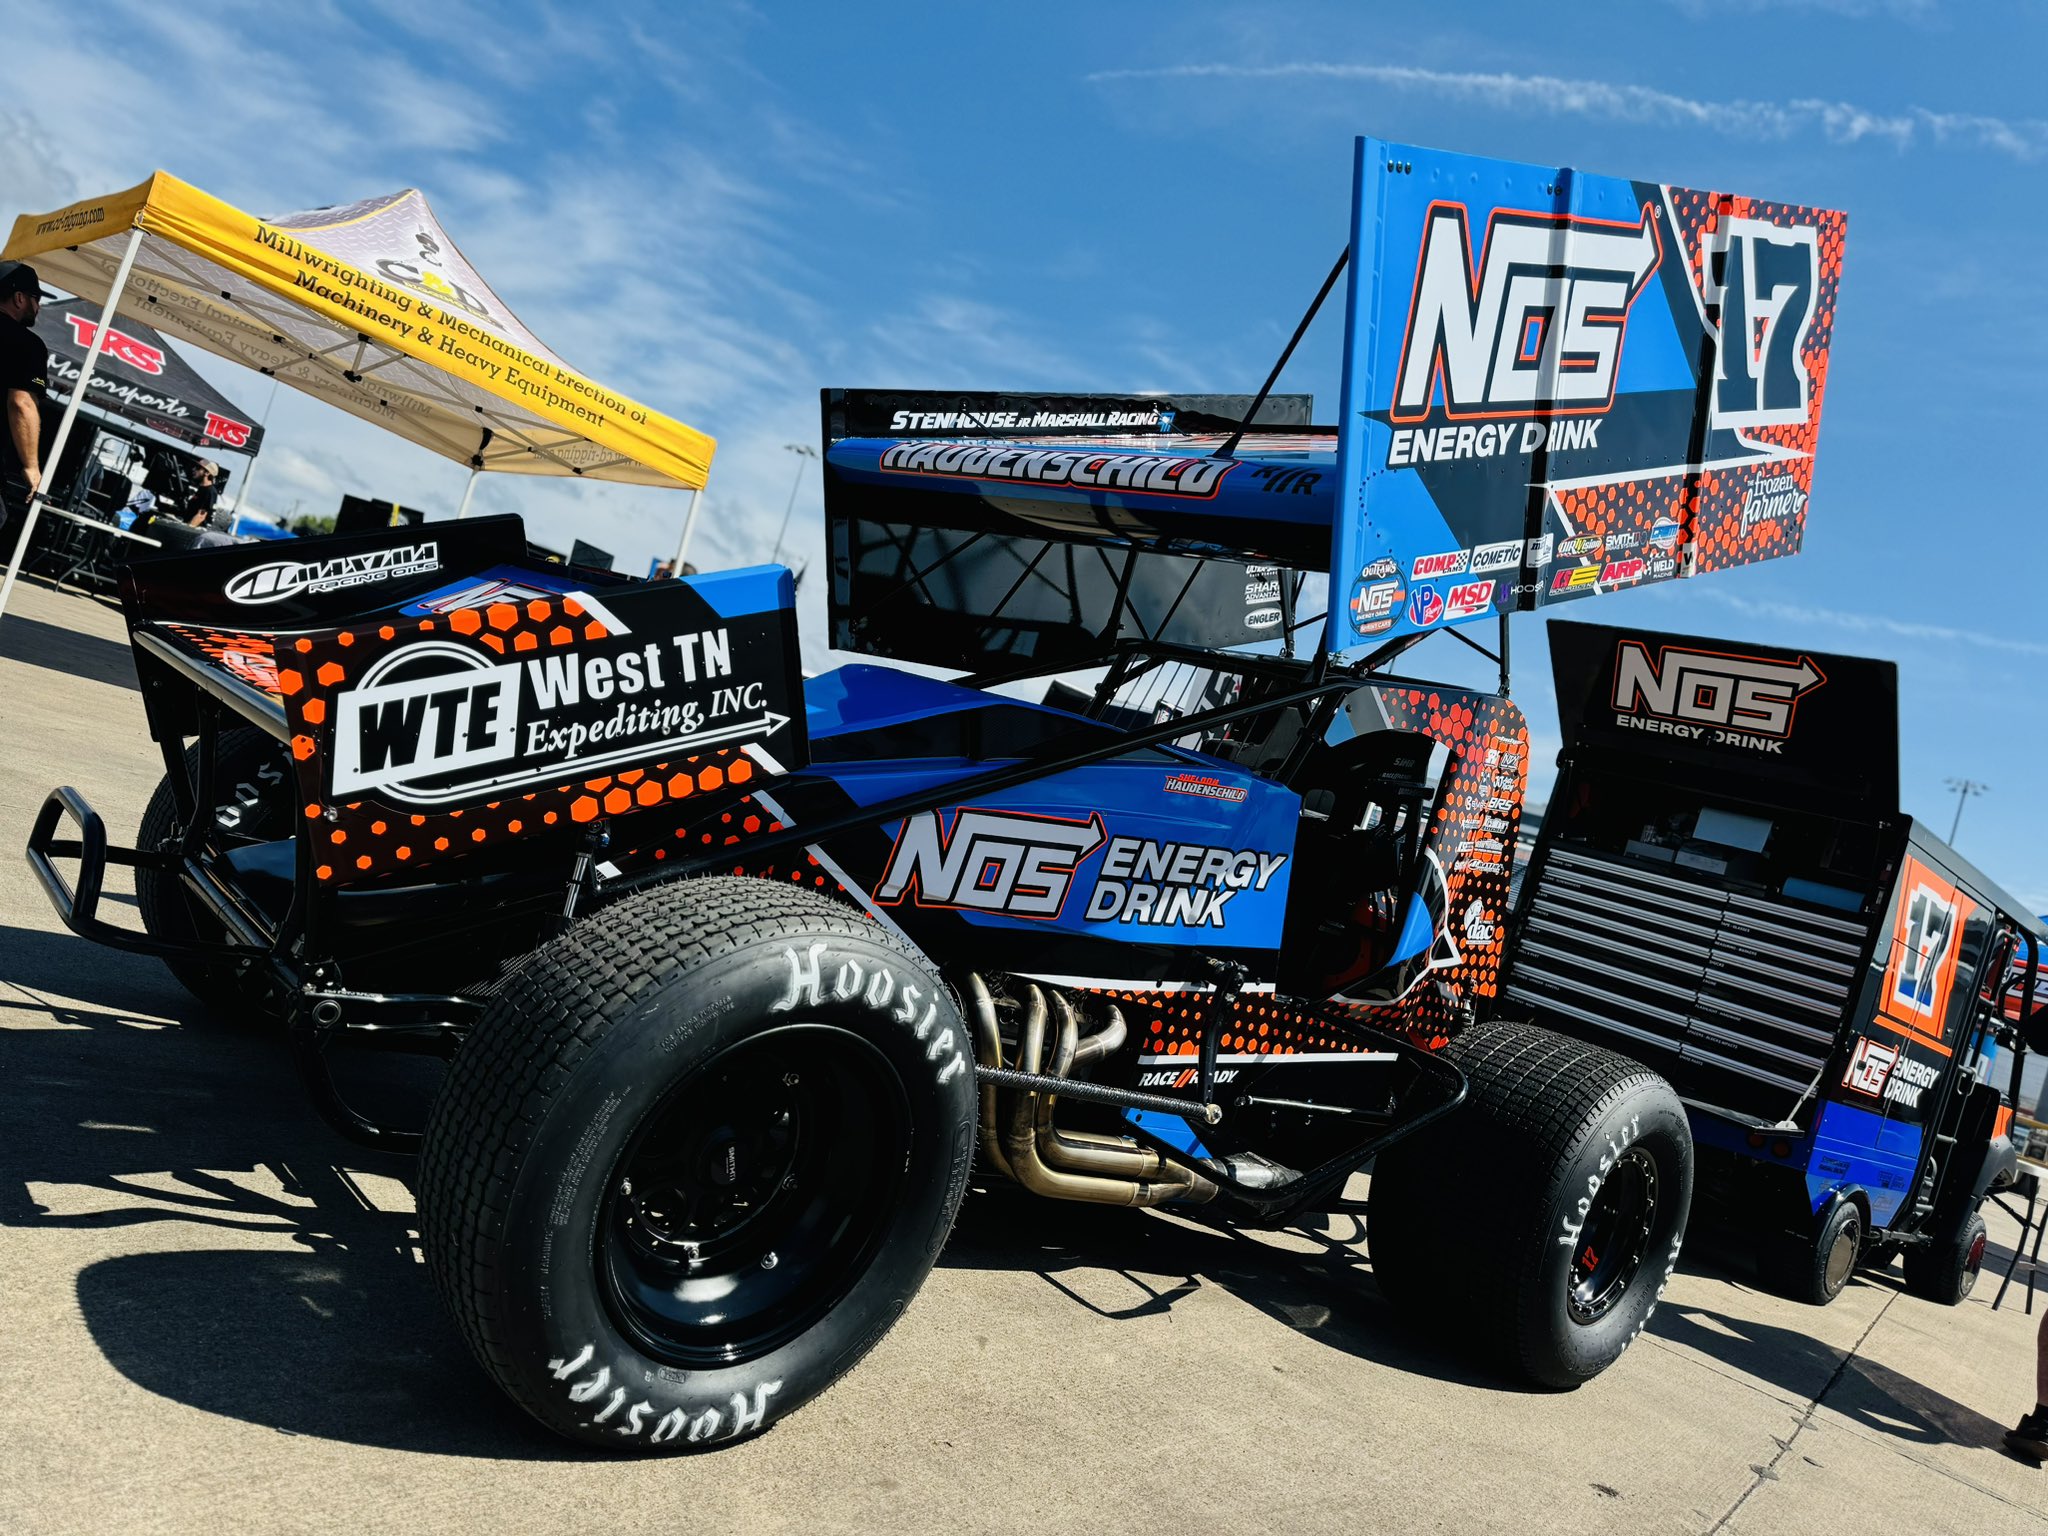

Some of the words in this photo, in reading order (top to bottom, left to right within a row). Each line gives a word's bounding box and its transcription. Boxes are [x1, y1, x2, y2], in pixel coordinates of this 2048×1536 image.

[253, 225, 412, 311] Millwrighting
[417, 302, 433, 319] &
[438, 311, 550, 377] Mechanical
[554, 370, 627, 416] Erection
[1392, 202, 1662, 420] NOS
[1703, 225, 1812, 422] 17
[293, 269, 414, 338] Machinery
[418, 327, 434, 345] &
[437, 335, 502, 380] Heavy
[505, 367, 605, 427] Equipment
[890, 410, 1019, 430] STENHOUSE
[1031, 412, 1106, 428] MARSHALL
[1109, 411, 1159, 427] RACING
[1389, 423, 1519, 465] ENERGY
[1519, 419, 1603, 453] DRINK
[881, 441, 1240, 498] HAUDENSCHILD
[1740, 488, 1808, 538] farmer
[308, 572, 388, 594] RACING
[391, 562, 439, 577] OILS
[1414, 553, 1457, 576] COMP
[1473, 543, 1521, 568] COMETIC
[1601, 559, 1643, 582] ARP
[1653, 558, 1675, 573] WELD
[1248, 611, 1280, 625] ENGLER
[1411, 585, 1434, 625] VP
[1448, 582, 1493, 609] MSD
[527, 643, 664, 710] West
[673, 628, 731, 683] TN
[1612, 641, 1825, 736] NOS
[358, 679, 505, 775] WTE
[523, 698, 705, 760] Expediting,
[710, 682, 767, 718] INC.
[1616, 714, 1705, 740] ENERGY
[1714, 730, 1785, 755] DRINK
[1166, 778, 1247, 800] HAUDENSCHILD
[876, 808, 1104, 918] NOS
[1100, 836, 1287, 891] ENERGY
[1085, 881, 1235, 927] DRINK
[767, 943, 966, 1083] Hoosier
[1842, 1036, 1900, 1098] NOS
[1892, 1055, 1940, 1090] ENERGY
[1883, 1077, 1924, 1109] DRINK
[1581, 1245, 1600, 1272] 17
[548, 1345, 784, 1444] Hoosier
